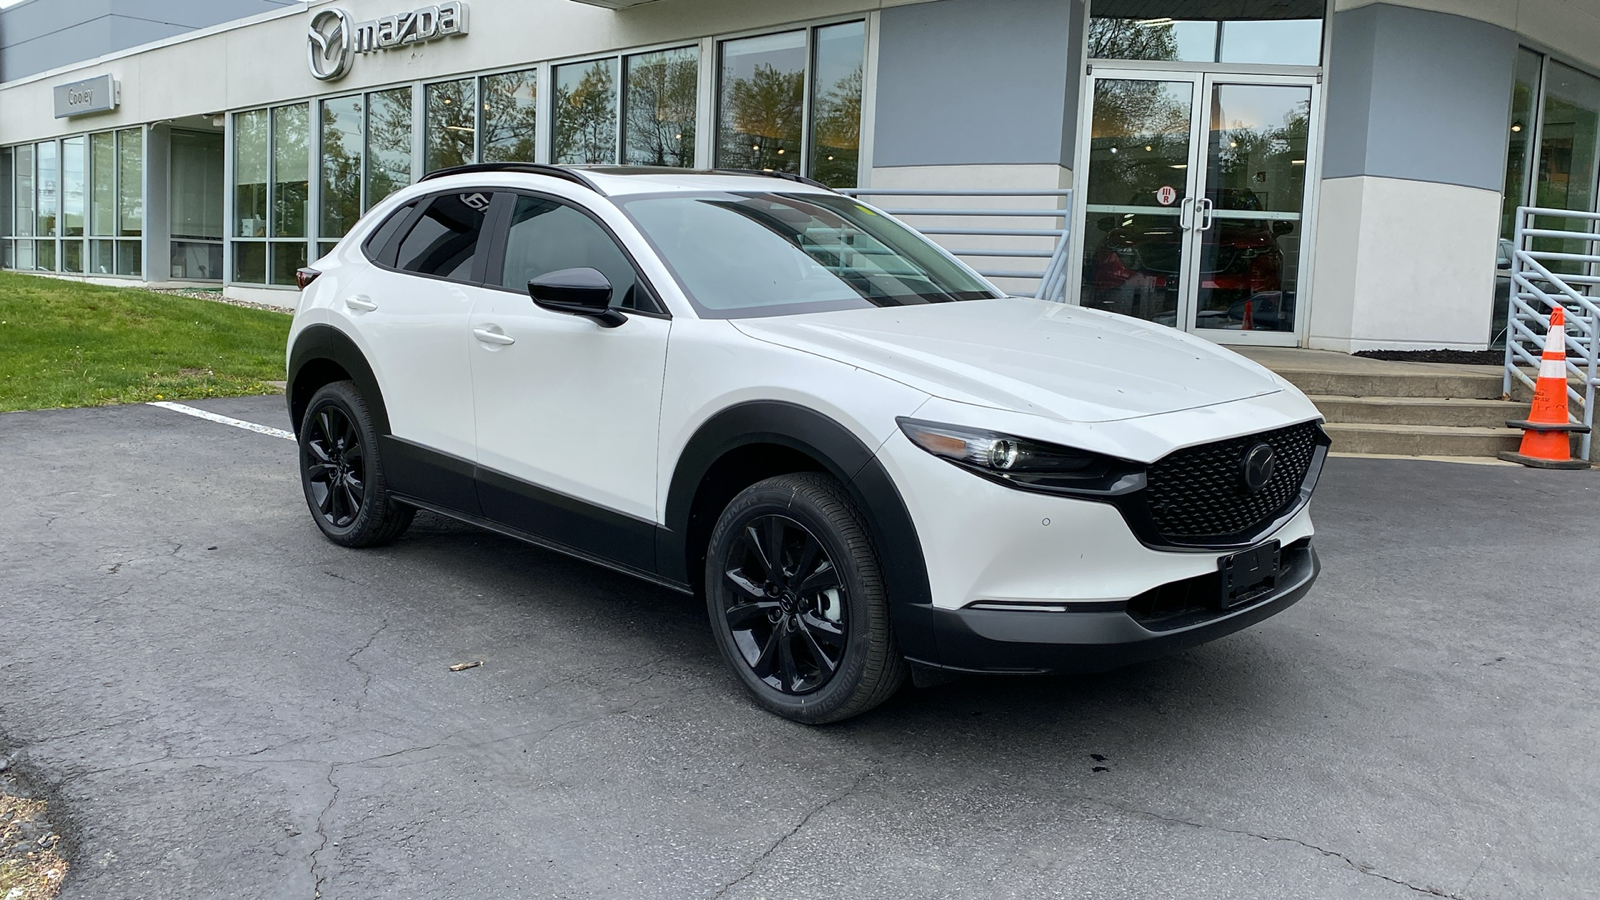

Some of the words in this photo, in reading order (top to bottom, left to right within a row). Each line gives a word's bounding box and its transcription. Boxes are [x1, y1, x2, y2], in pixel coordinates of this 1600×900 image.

[355, 1, 468, 54] mazda
[68, 84, 94, 107] Cooley
[803, 653, 861, 717] BRIDGESTO
